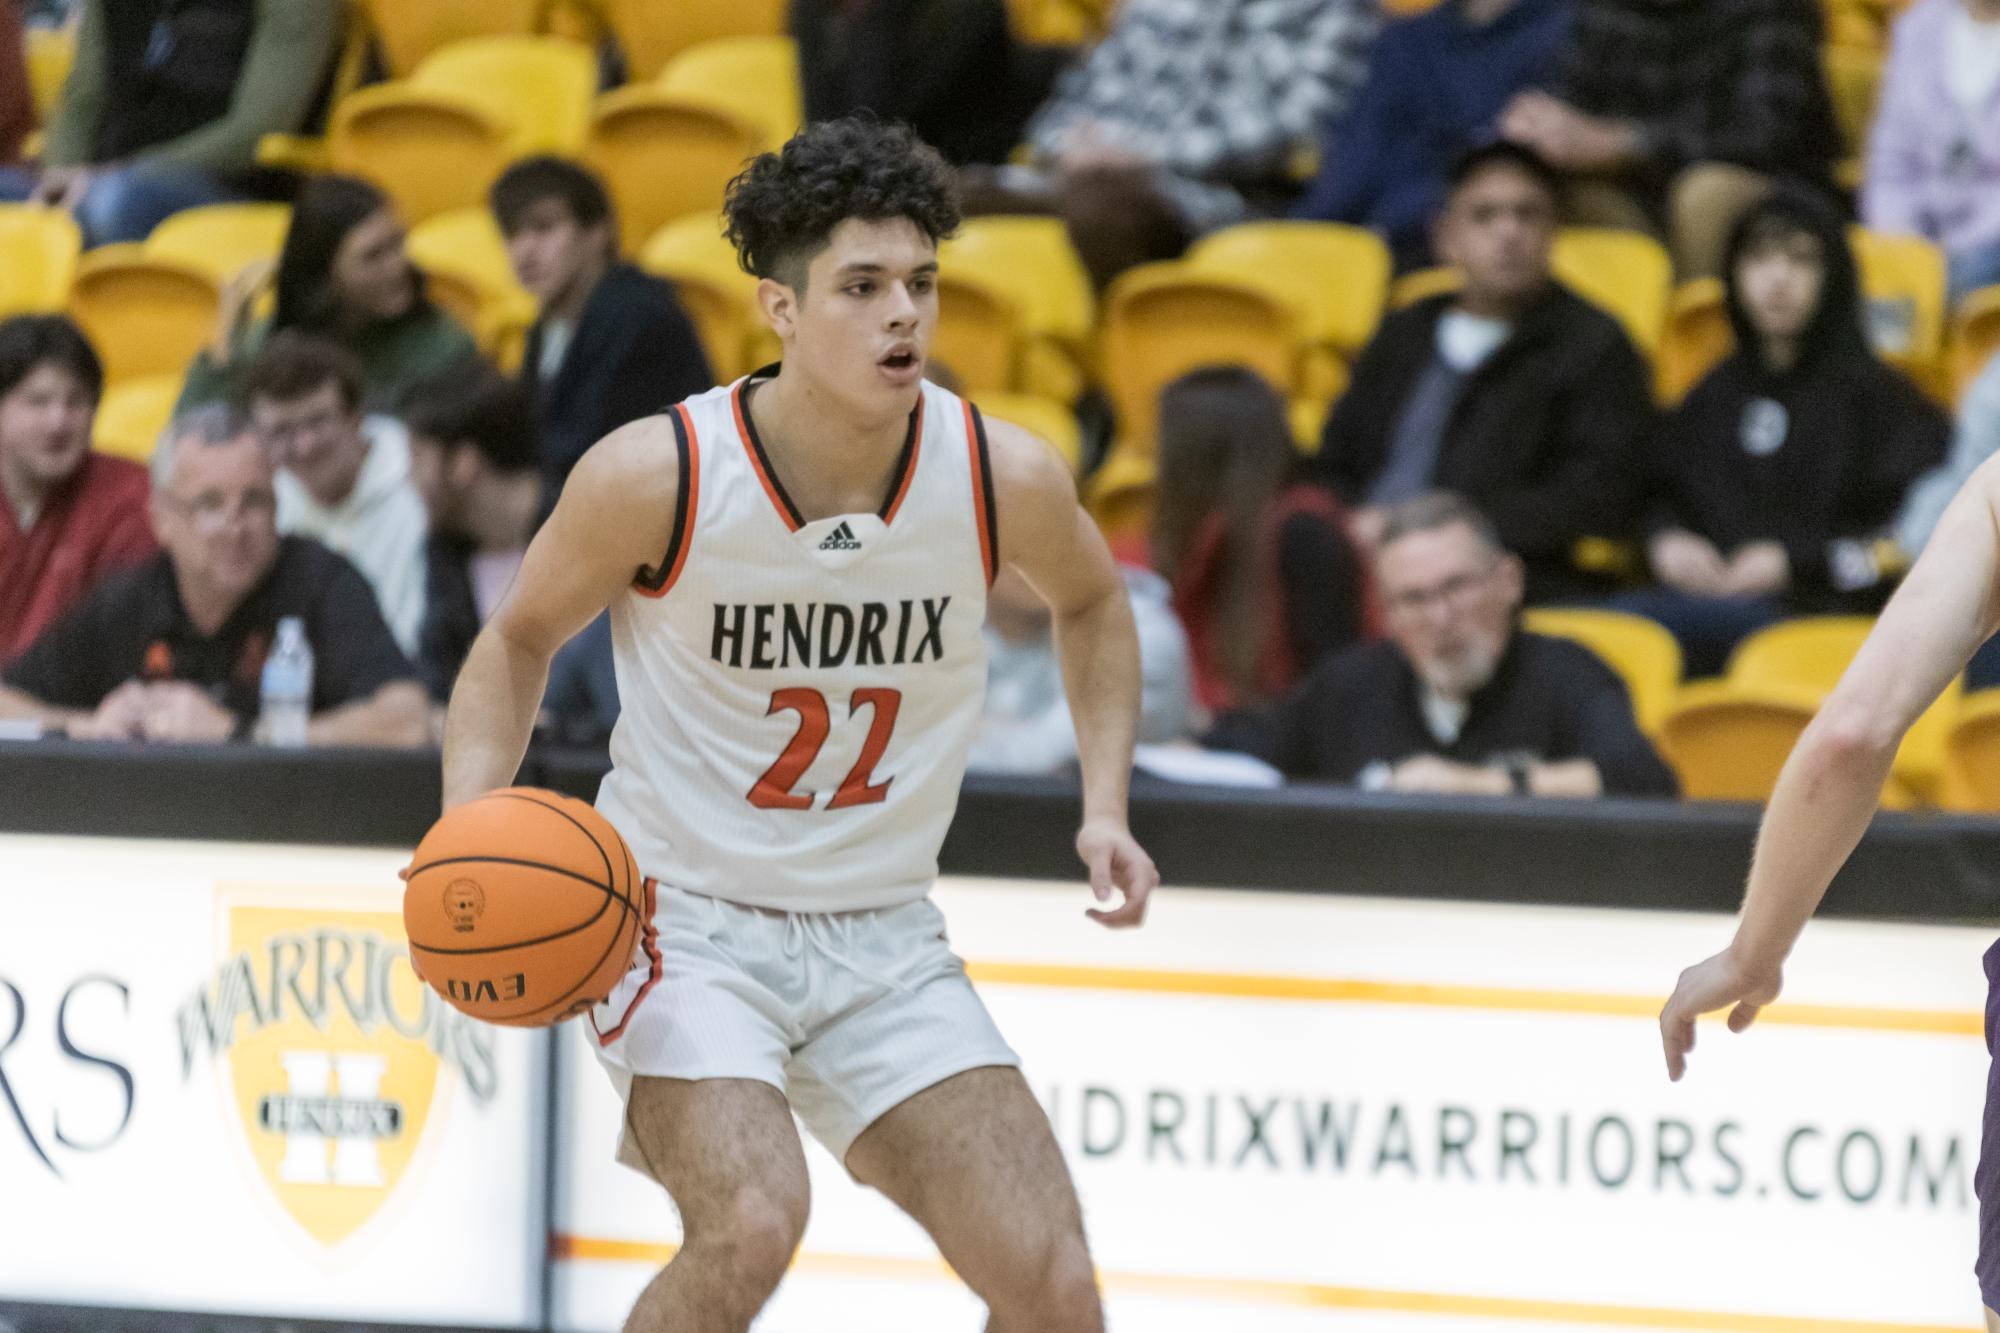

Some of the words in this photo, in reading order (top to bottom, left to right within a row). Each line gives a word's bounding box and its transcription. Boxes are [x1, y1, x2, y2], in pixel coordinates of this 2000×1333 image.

[819, 540, 862, 550] adidas
[710, 596, 952, 670] HENDRIX
[746, 687, 902, 811] 22
[1050, 1084, 1968, 1210] DRIXWARRIORS.COM
